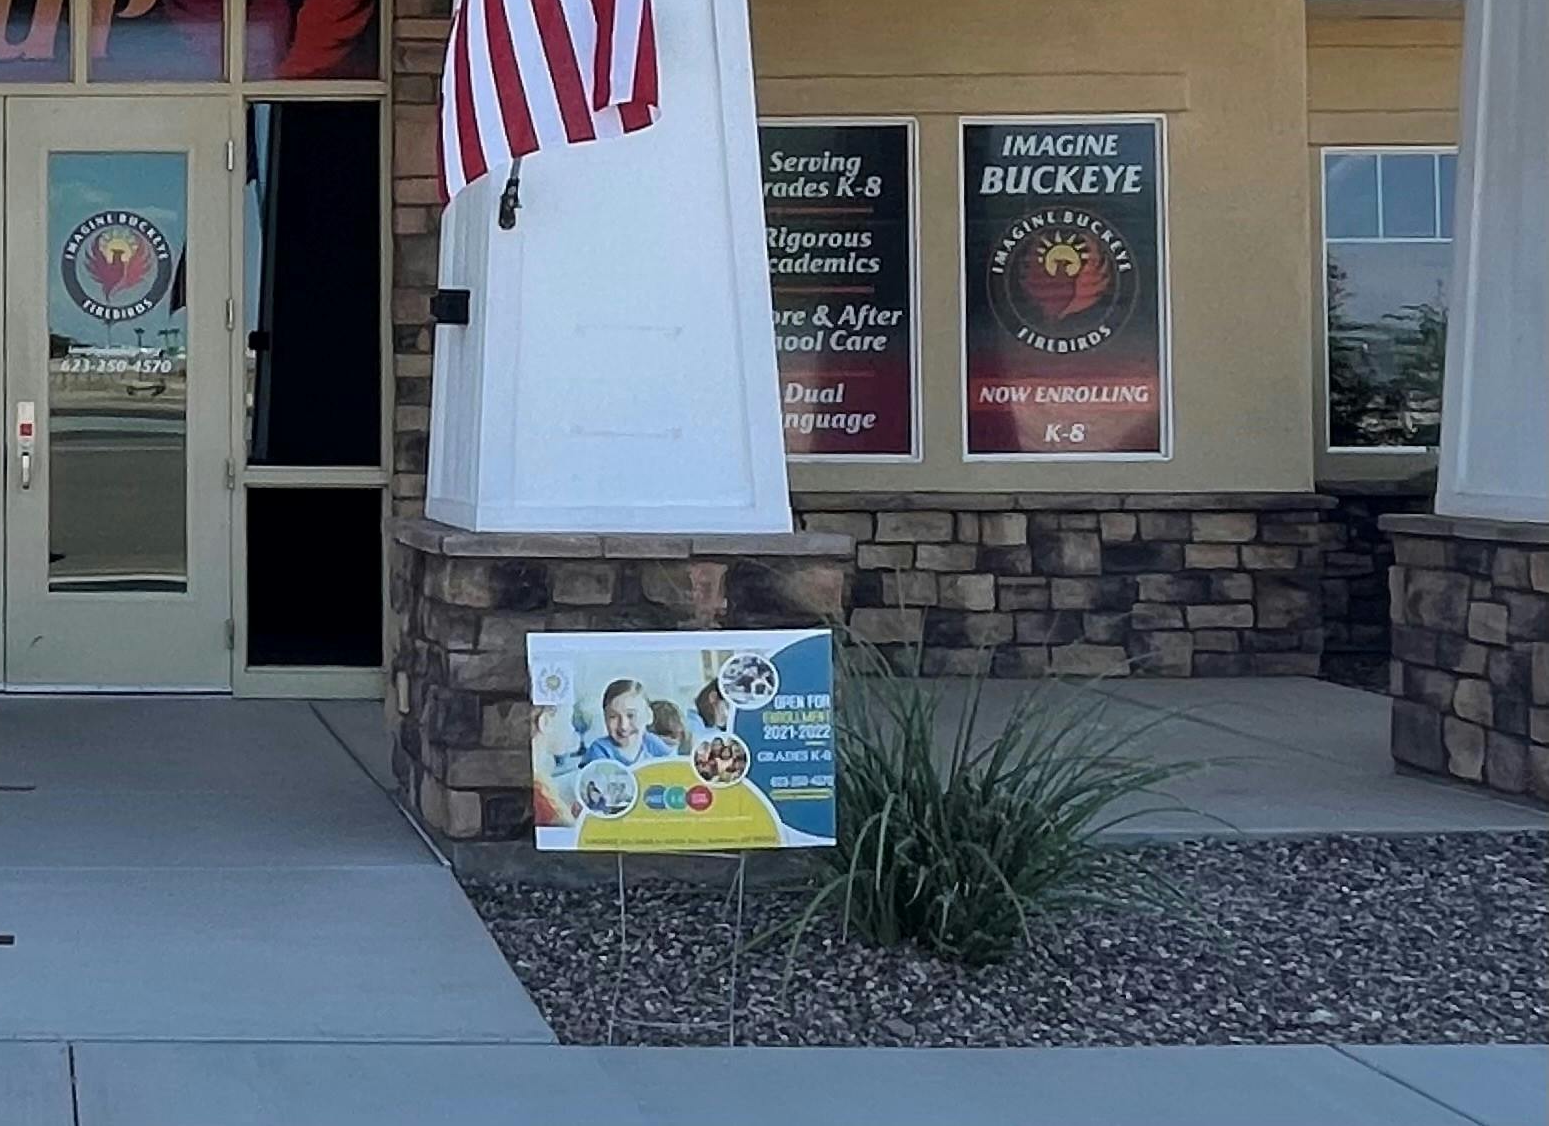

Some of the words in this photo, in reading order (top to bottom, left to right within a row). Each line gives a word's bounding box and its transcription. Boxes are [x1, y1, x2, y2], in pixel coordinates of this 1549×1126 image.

[1002, 134, 1118, 156] IMAGINE
[769, 150, 861, 177] Serving
[763, 176, 830, 197] rades
[835, 175, 882, 197] K-8
[979, 164, 1142, 194] BUCKEYE
[65, 213, 114, 260] IMAGINE
[119, 213, 169, 259] BUCKEYE
[992, 211, 1056, 274] IMAGINE
[1063, 211, 1132, 272] BUCKEYE
[769, 252, 882, 273] cademics
[82, 299, 154, 320] FIREBIRDS
[811, 305, 834, 328] &
[837, 304, 903, 331] After
[830, 329, 888, 351] Care
[1017, 324, 1112, 353] FIREBIRDS
[784, 382, 845, 403] Dual
[979, 385, 1030, 403] NOW
[1034, 385, 1148, 403] ENROLLING
[784, 412, 876, 434] nguage
[1044, 423, 1085, 442] K-8
[774, 694, 805, 710] OPEN
[763, 724, 832, 740] 2021-2022
[757, 750, 809, 763] GRADES
